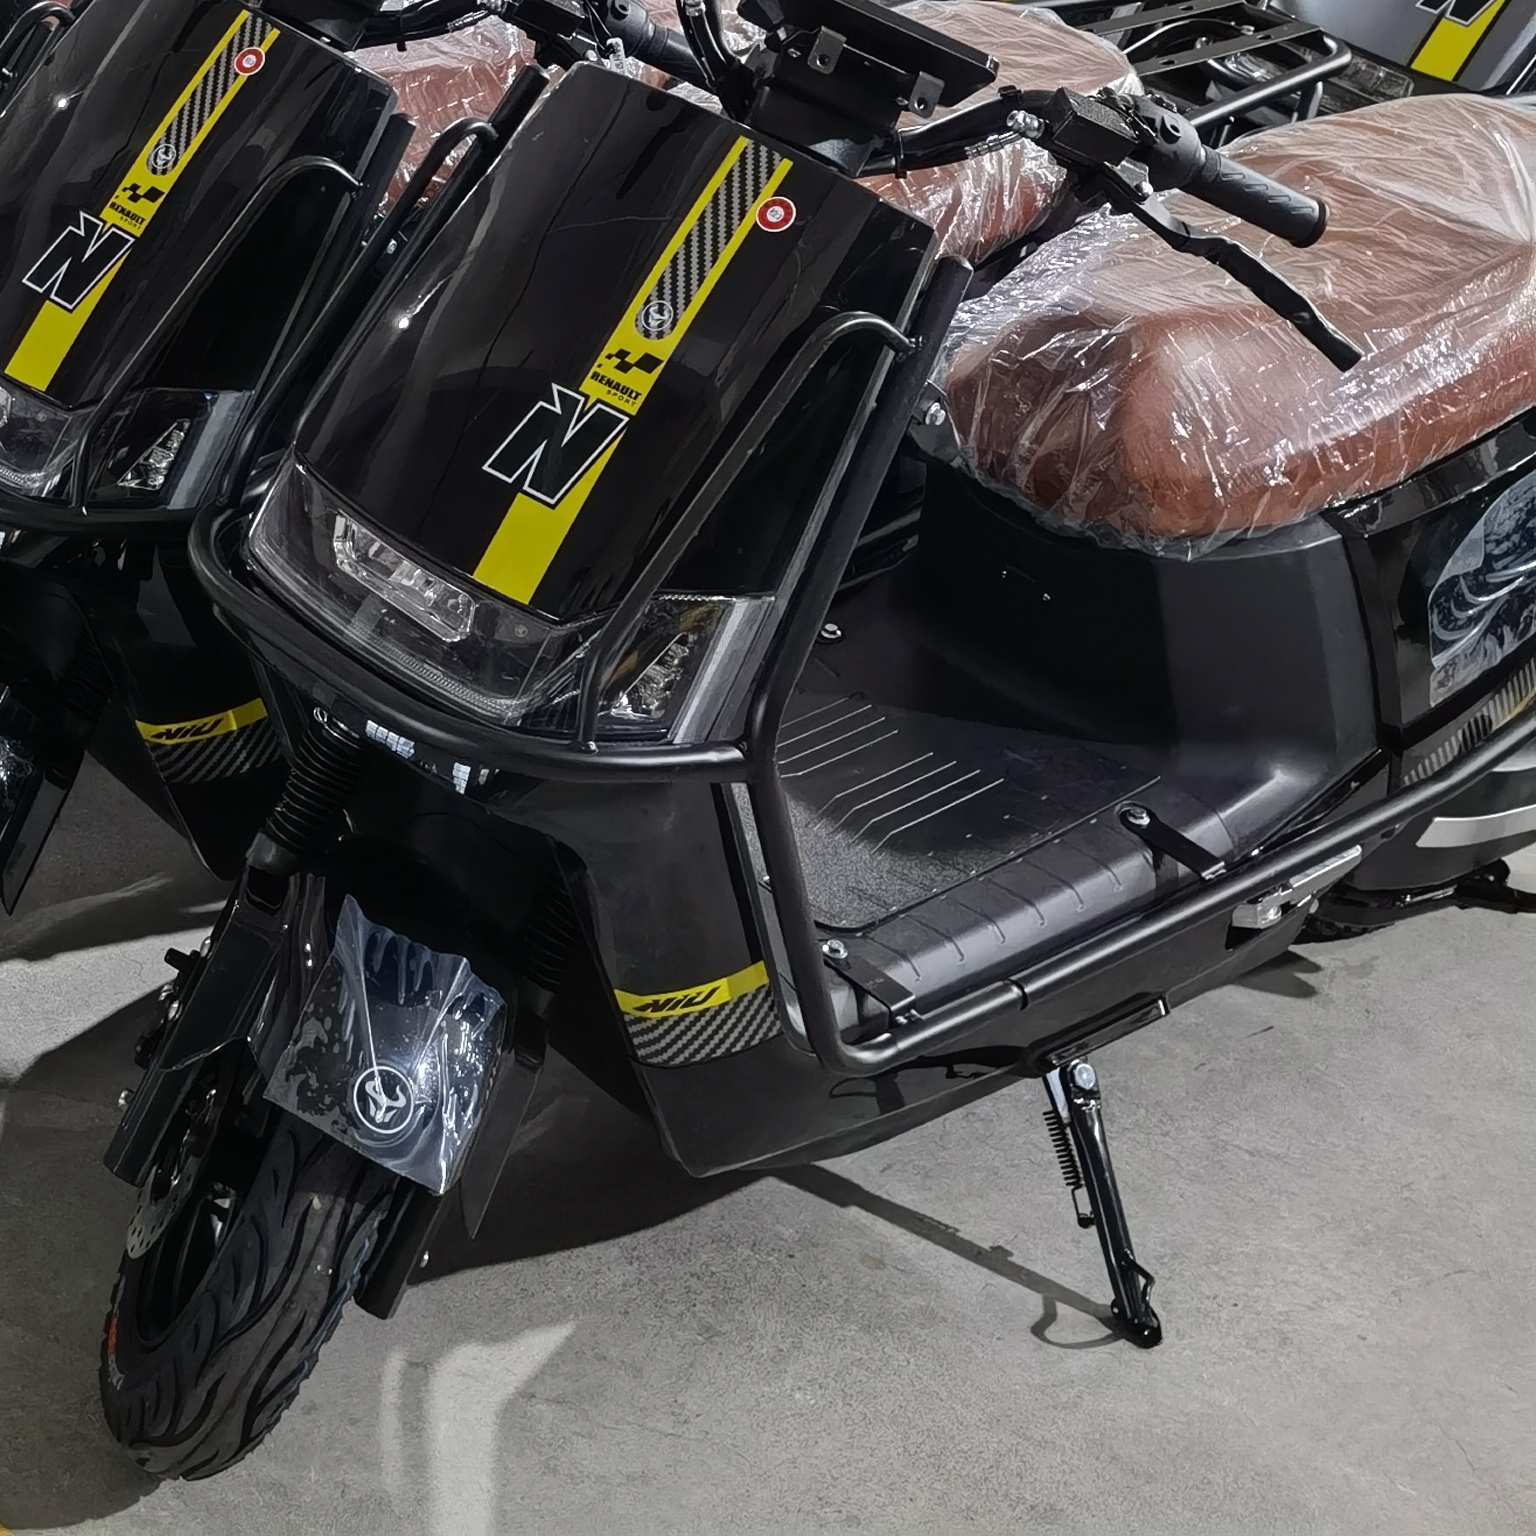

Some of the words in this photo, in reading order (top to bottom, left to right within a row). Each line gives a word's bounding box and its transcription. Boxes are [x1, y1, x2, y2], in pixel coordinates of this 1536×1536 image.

[109, 201, 145, 227] RENAULT
[22, 211, 135, 310] N
[590, 370, 642, 404] RENAULT
[606, 388, 637, 408] SPORT
[481, 382, 630, 506] N
